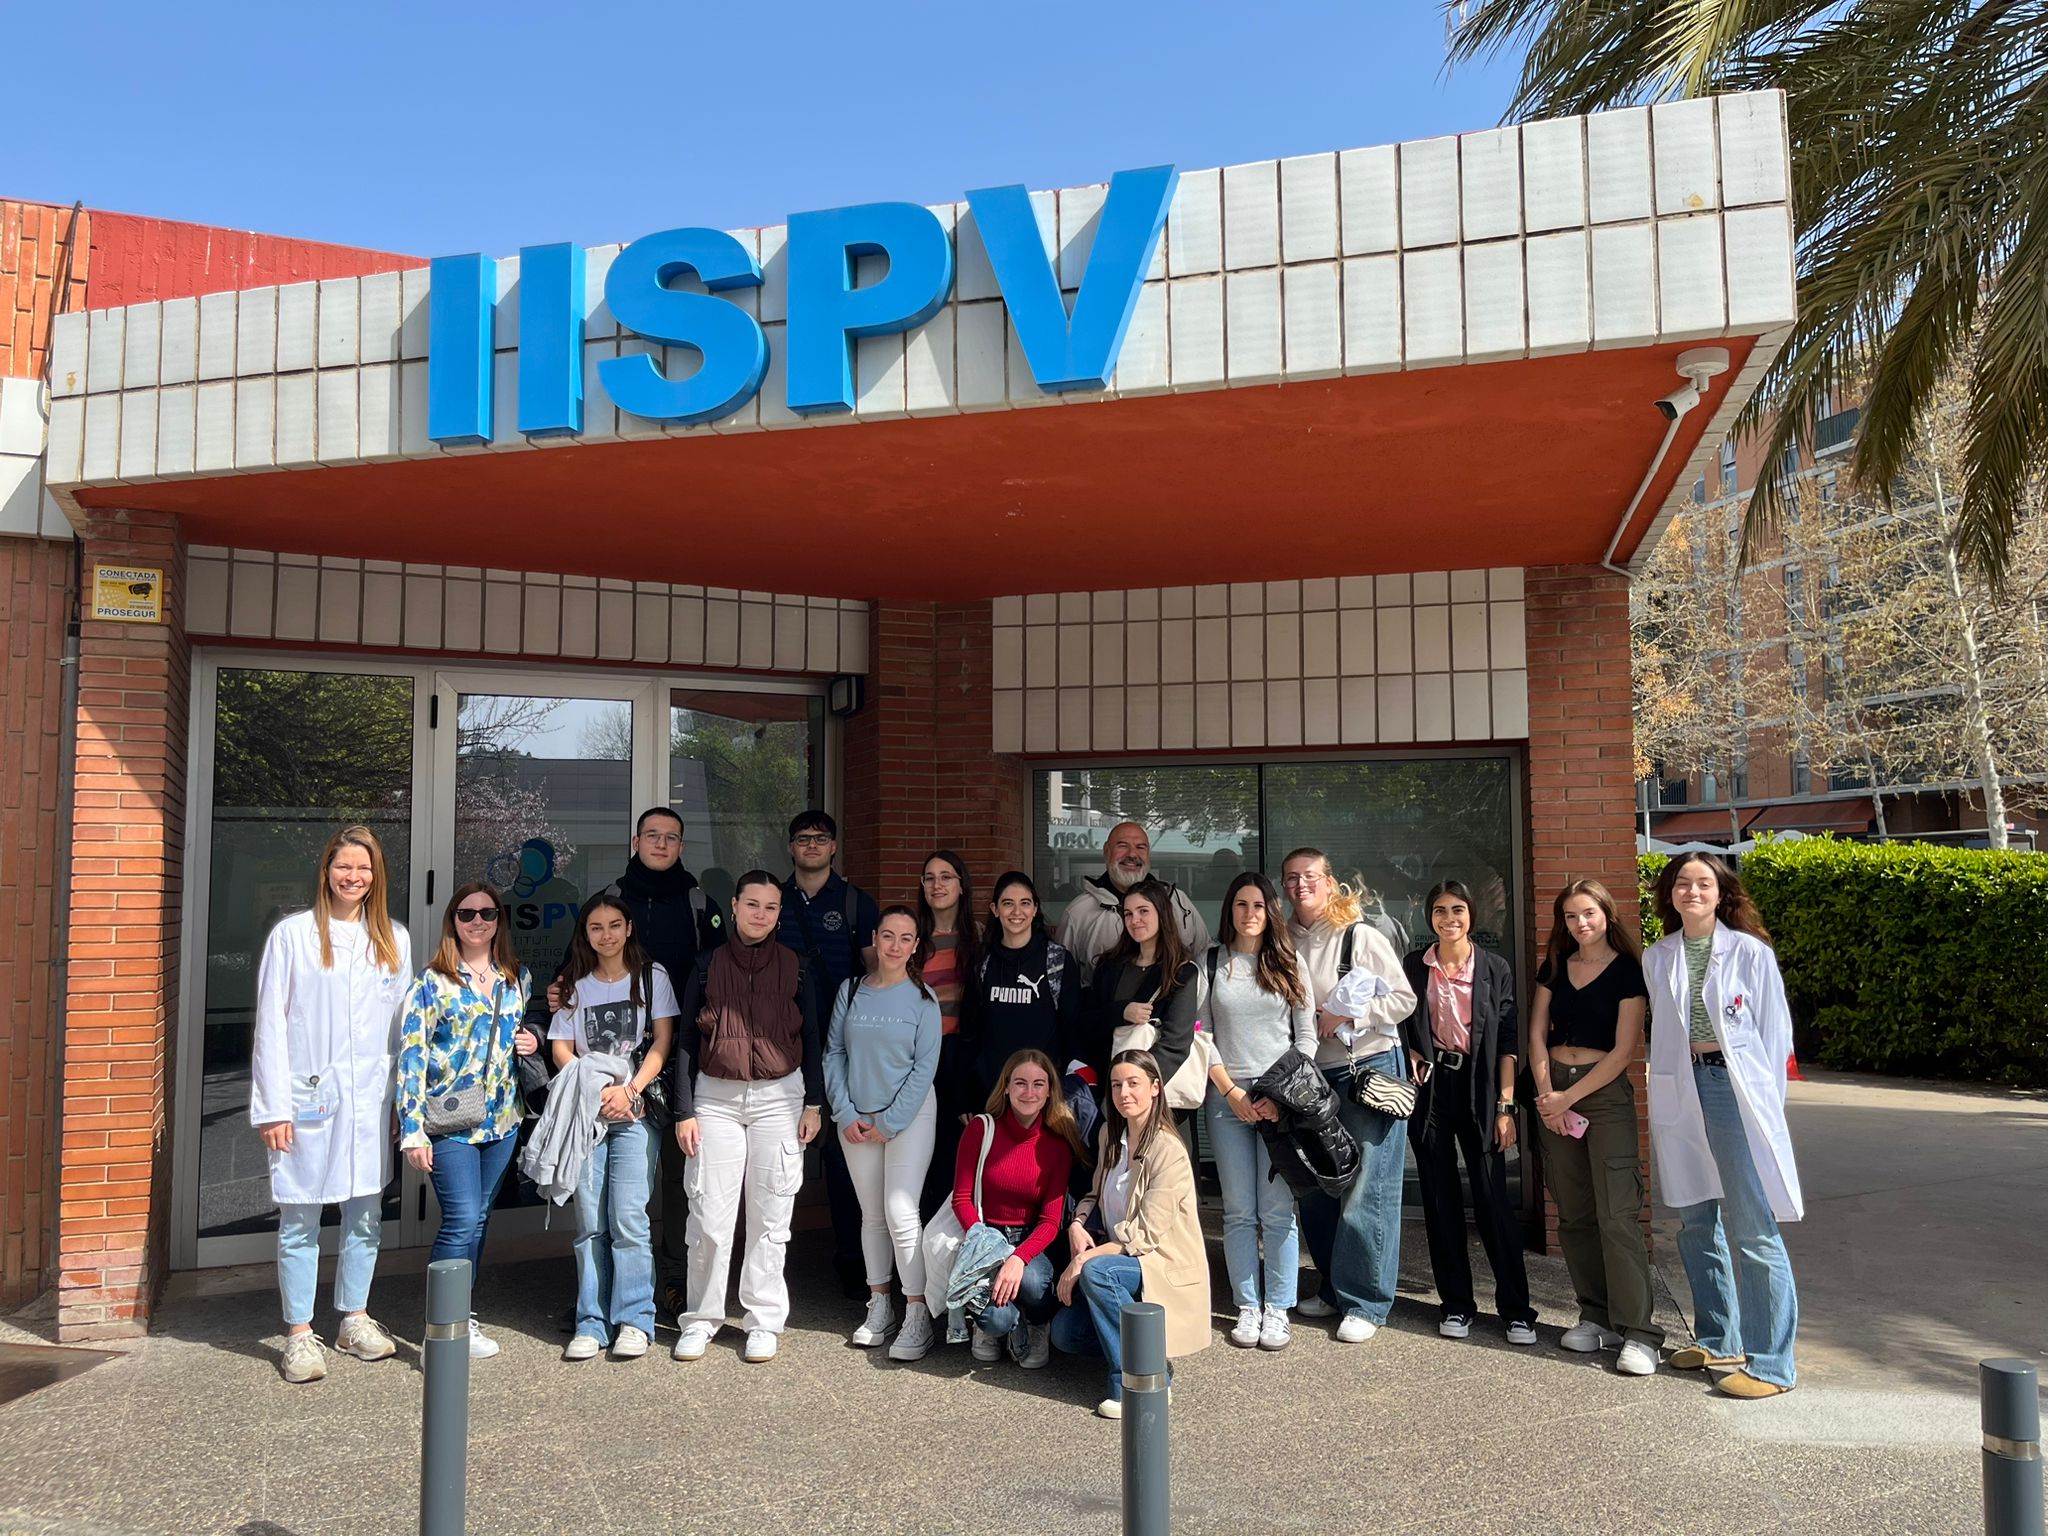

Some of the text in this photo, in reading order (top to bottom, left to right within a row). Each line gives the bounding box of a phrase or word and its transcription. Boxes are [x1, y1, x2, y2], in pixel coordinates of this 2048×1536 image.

[428, 164, 1178, 446] IISPV
[99, 569, 157, 579] CONECTADA
[97, 608, 156, 618] PROSEGUR
[512, 935, 551, 945] TITUT
[989, 986, 1033, 1004] PUMA
